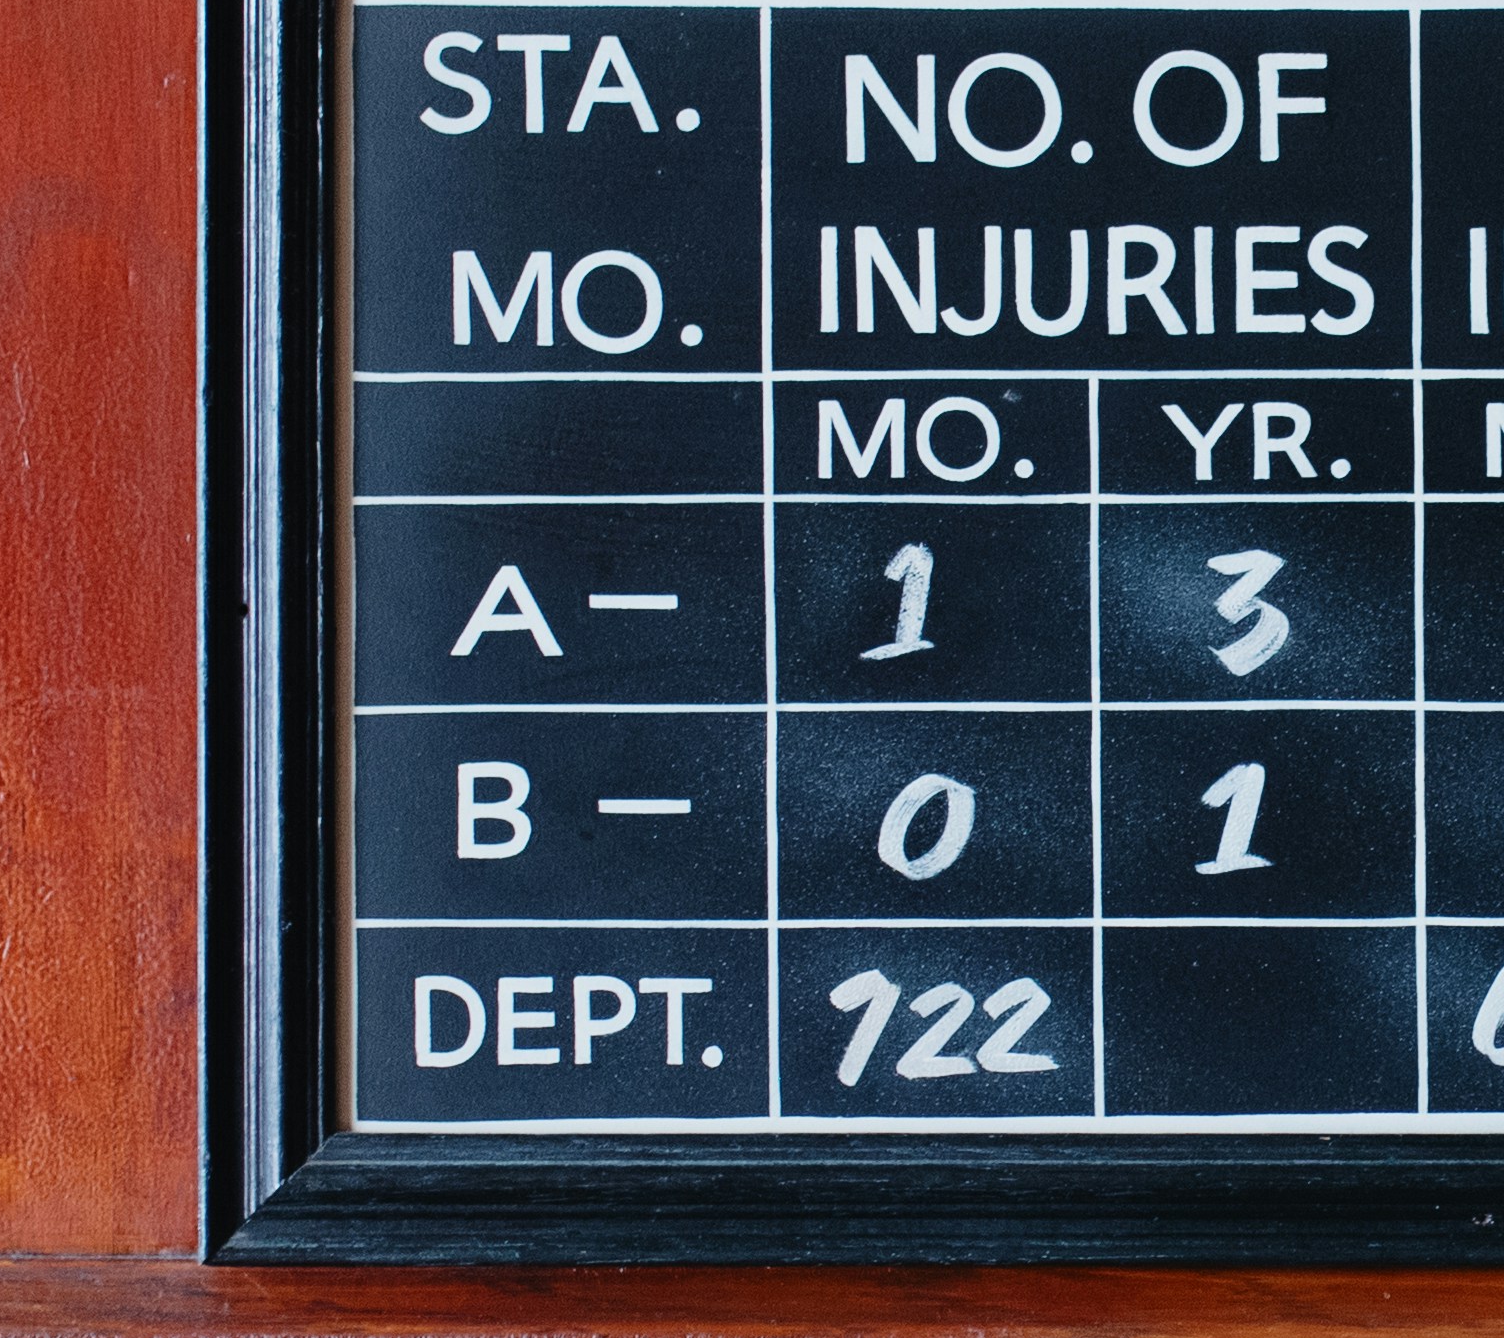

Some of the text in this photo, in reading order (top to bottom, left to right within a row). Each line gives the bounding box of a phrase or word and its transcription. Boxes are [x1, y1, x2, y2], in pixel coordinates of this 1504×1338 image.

[420, 32, 702, 135] STA.
[846, 50, 1328, 167] NO. OF
[453, 250, 703, 355] MO.
[819, 225, 1375, 337] INJURIES
[819, 397, 1034, 483] MO.
[1162, 402, 1352, 481] YR.
[860, 541, 936, 662] 1
[1207, 549, 1292, 678] 3
[877, 773, 976, 881] 0
[1195, 763, 1272, 875] 1
[414, 975, 724, 1069] DEPT.
